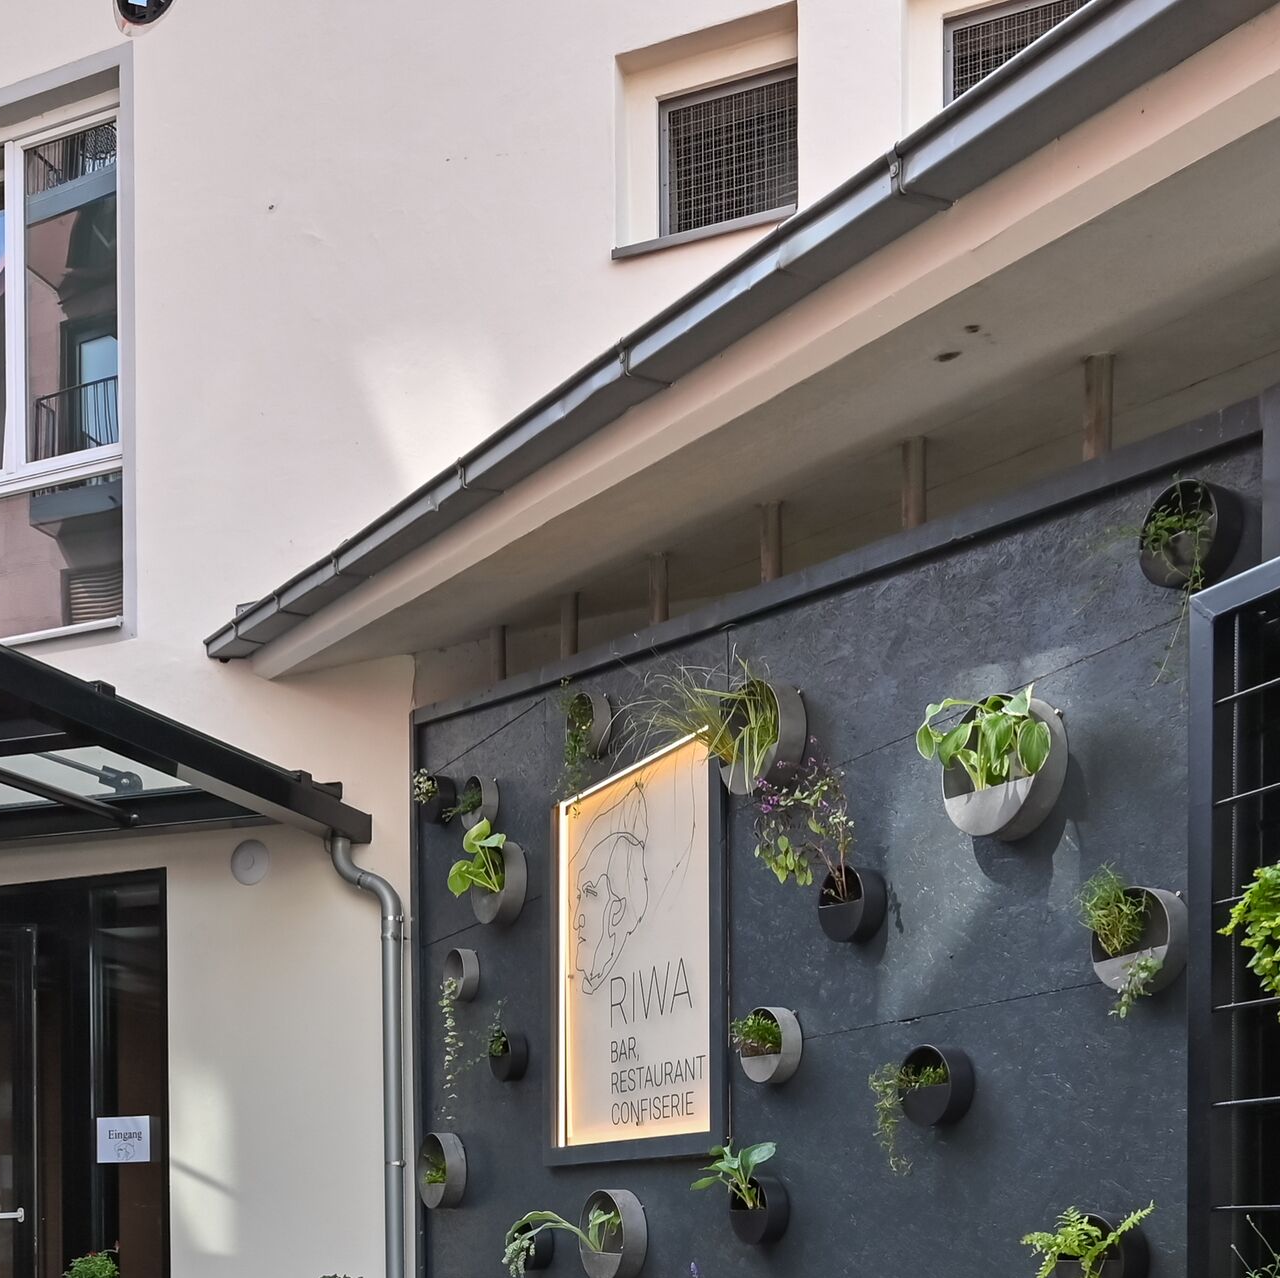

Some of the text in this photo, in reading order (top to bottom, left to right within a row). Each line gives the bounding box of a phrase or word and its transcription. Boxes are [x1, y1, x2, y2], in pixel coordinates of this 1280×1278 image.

[609, 957, 694, 1029] RIWA
[610, 1036, 640, 1065] BAR,
[610, 1054, 707, 1094] RESTAURANT
[610, 1091, 695, 1127] CONFISERIE
[108, 1129, 143, 1142] Eingang
